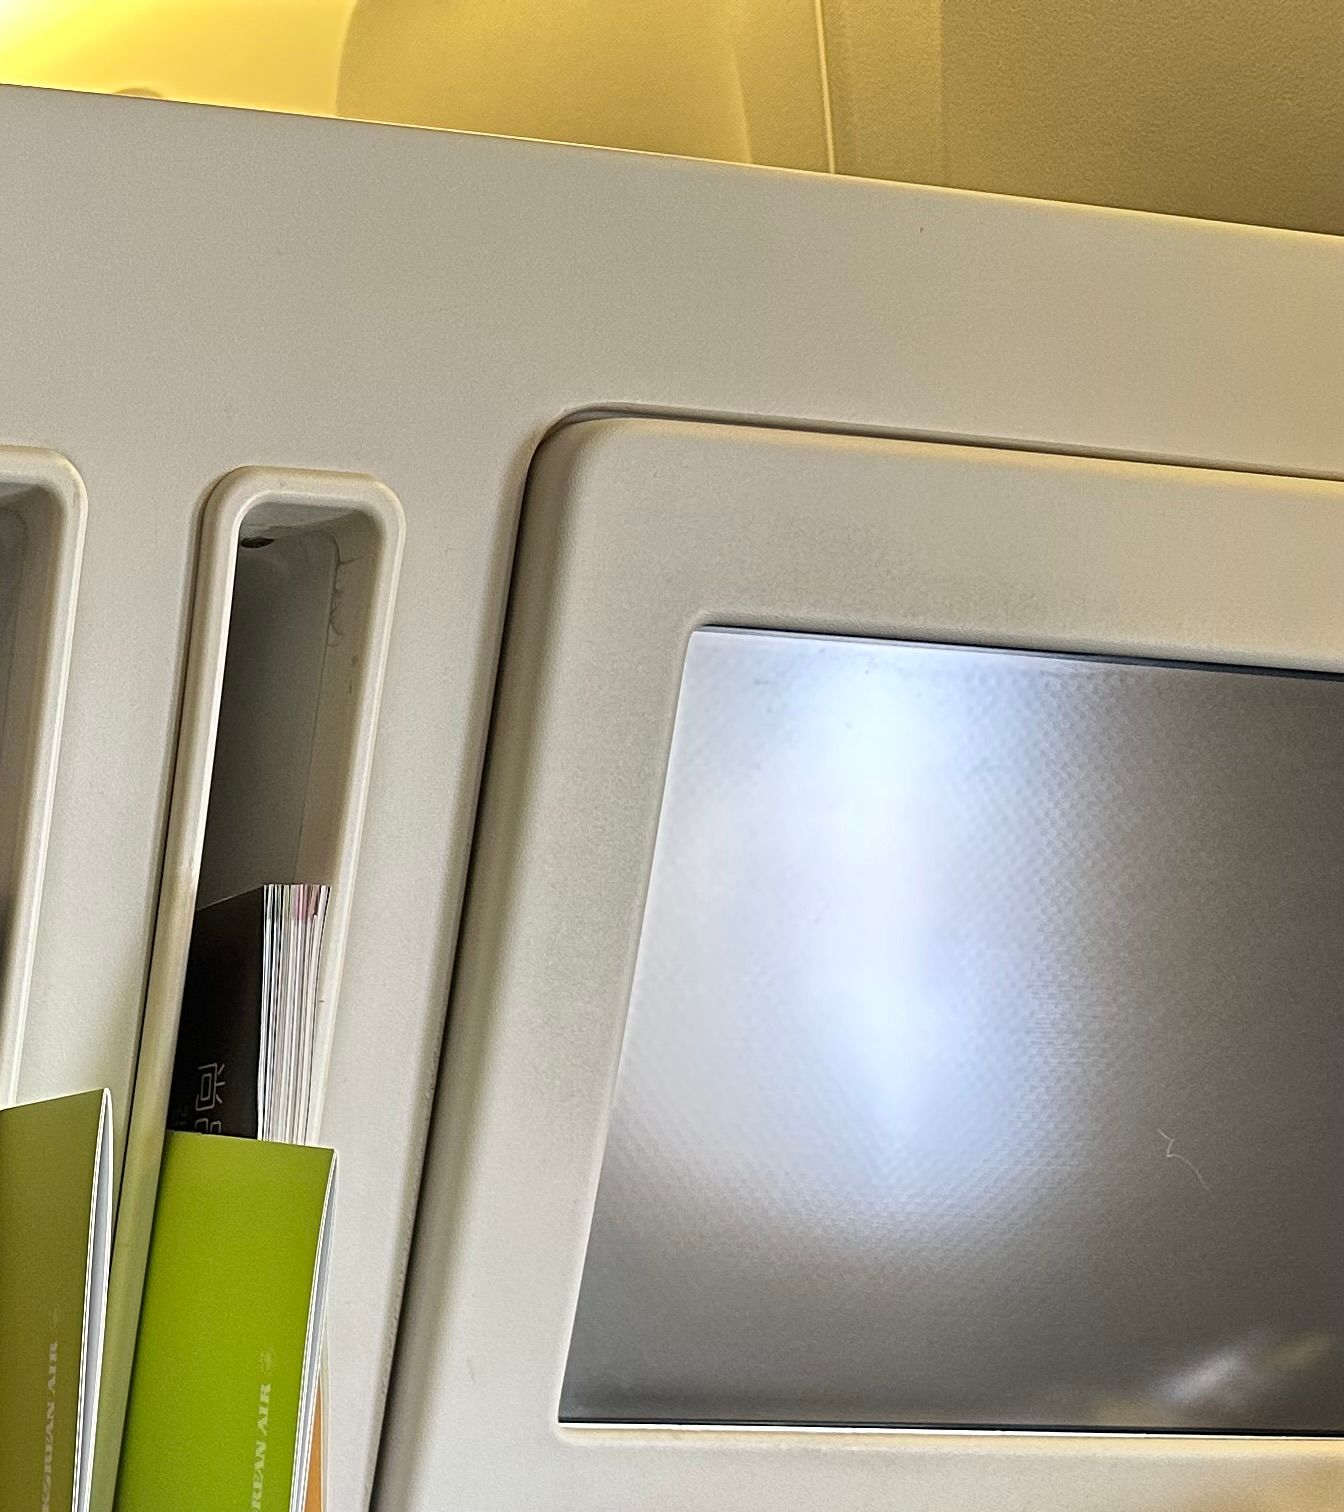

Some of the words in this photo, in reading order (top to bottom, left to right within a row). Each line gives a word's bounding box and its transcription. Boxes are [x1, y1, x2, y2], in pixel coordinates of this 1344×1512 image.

[48, 1340, 58, 1392] AIR
[257, 1384, 271, 1436] AIR
[42, 1402, 55, 1512] KOREAN
